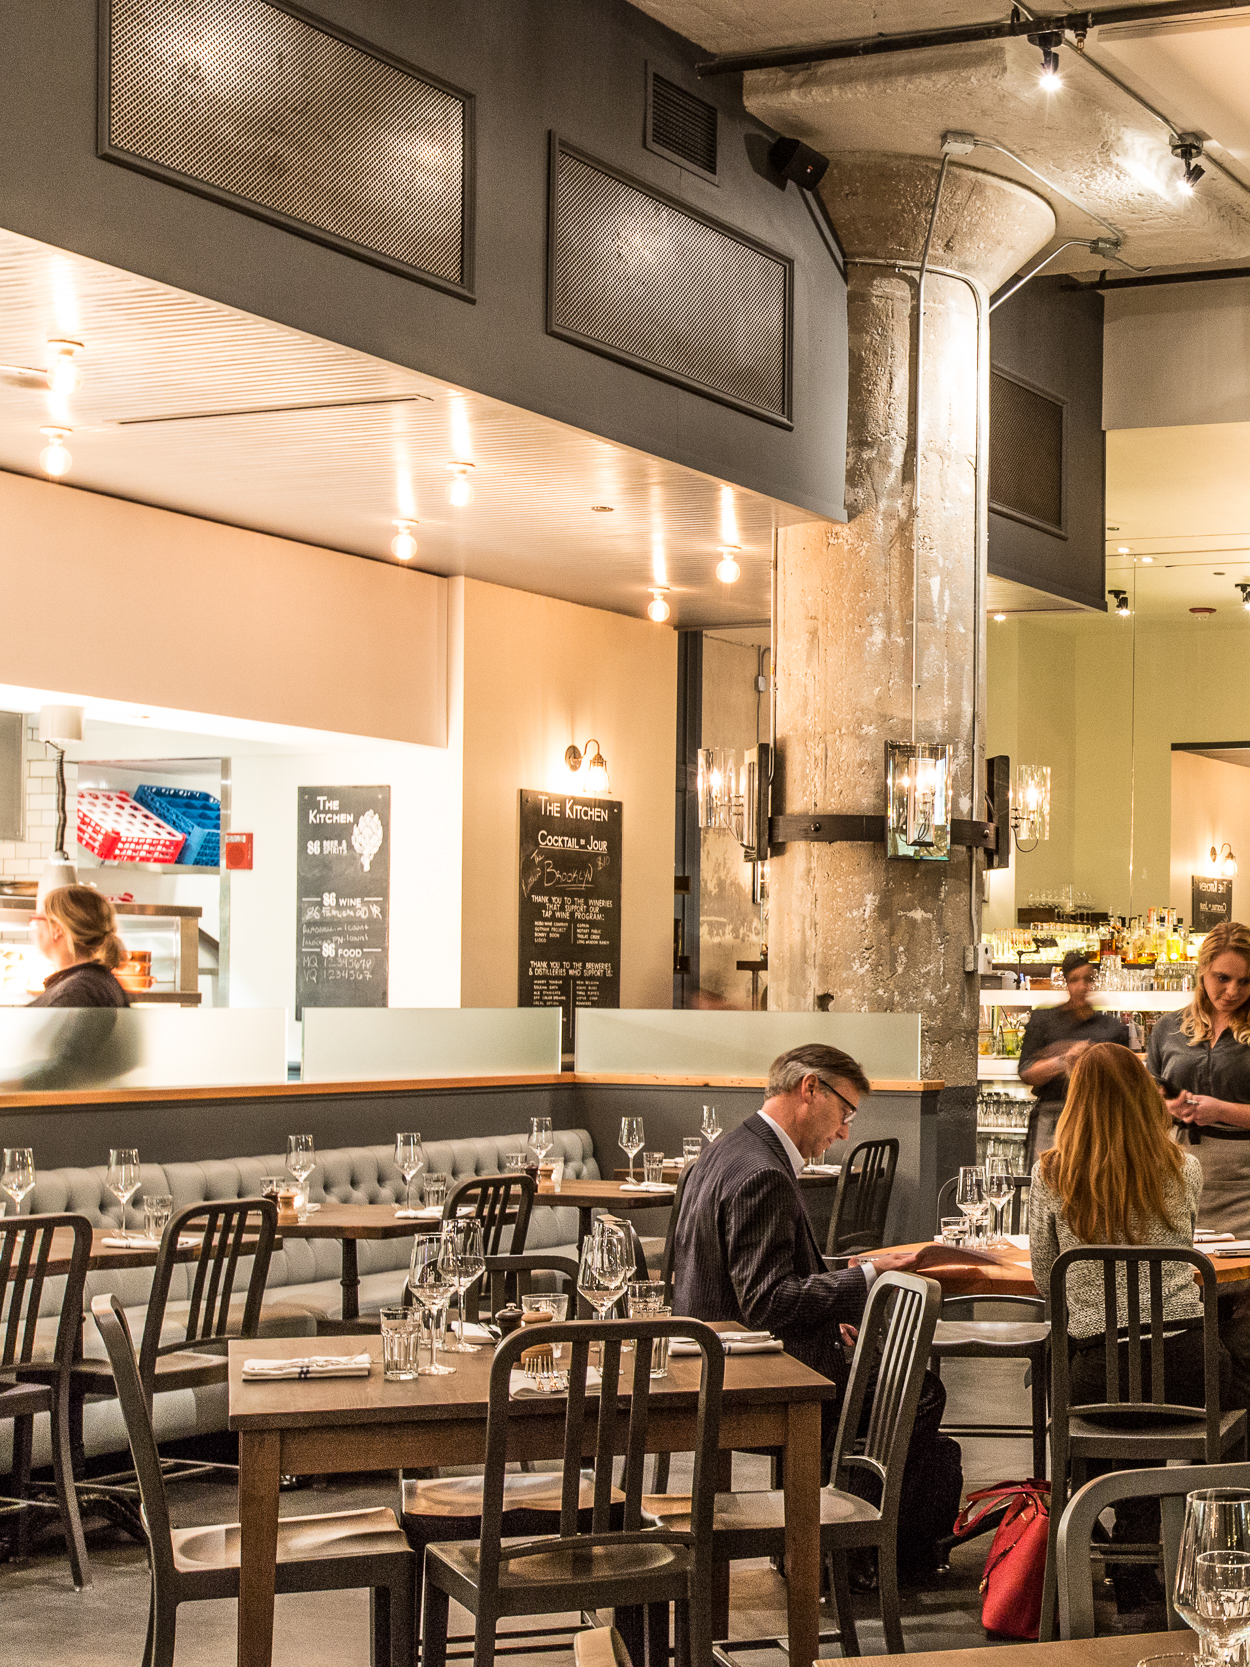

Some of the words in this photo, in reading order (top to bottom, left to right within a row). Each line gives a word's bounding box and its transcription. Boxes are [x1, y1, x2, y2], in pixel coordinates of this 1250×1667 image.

[316, 795, 340, 811] THE
[538, 795, 561, 817] THE
[565, 798, 609, 822] KITCHEN
[308, 809, 354, 824] KITCHEN
[307, 840, 321, 855] 86
[538, 830, 580, 849] COCKTAIL
[587, 835, 608, 852] JOUR
[322, 892, 337, 906] 86
[339, 897, 362, 907] WINE
[531, 894, 549, 904] THANK
[551, 896, 562, 905] YOU
[564, 896, 572, 905] TO
[574, 897, 585, 906] THE
[588, 898, 613, 908] WINERIES
[542, 910, 553, 918] TAP
[555, 911, 570, 920] WINE
[546, 903, 560, 912] THAT
[565, 904, 587, 913] SUPPORT
[589, 906, 600, 914] OUR
[322, 943, 336, 957] 86
[338, 948, 362, 957] FOOD
[530, 960, 548, 969] THANK
[550, 961, 561, 969] YOU
[572, 962, 583, 970] THE
[586, 962, 612, 970] BREWERIES
[528, 968, 533, 976] &
[535, 968, 566, 976] DISTILLERIES
[584, 969, 604, 977] SUPPORT
